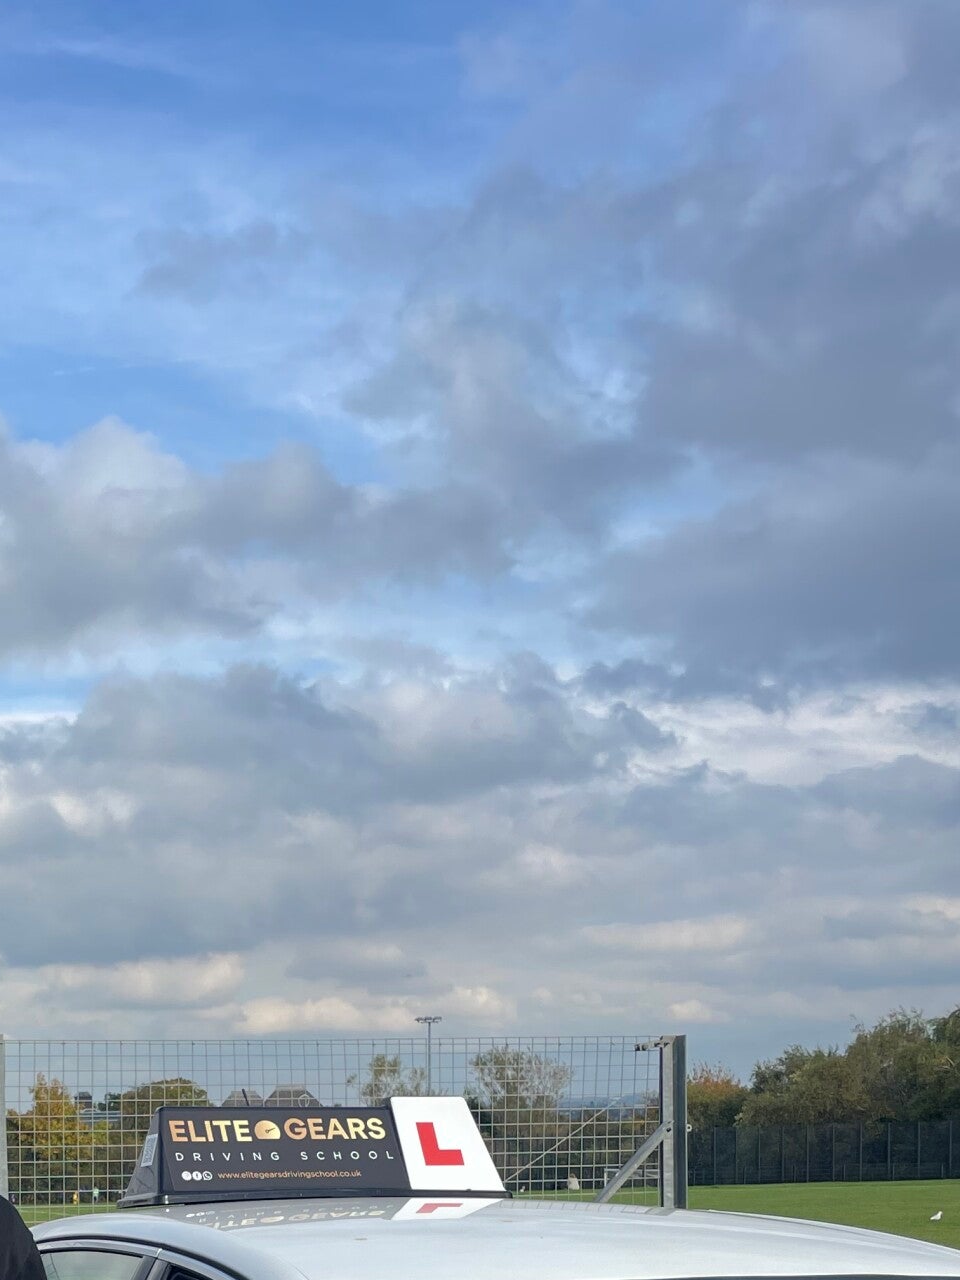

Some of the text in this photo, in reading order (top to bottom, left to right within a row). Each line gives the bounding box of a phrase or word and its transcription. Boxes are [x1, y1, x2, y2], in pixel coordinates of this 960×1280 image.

[168, 1117, 386, 1142] ELITE GEARS
[415, 1122, 465, 1166] L
[175, 1150, 394, 1162] DRIVING SCHOOL
[217, 1169, 362, 1181] www.elitegearsdrivingschool.co.uk
